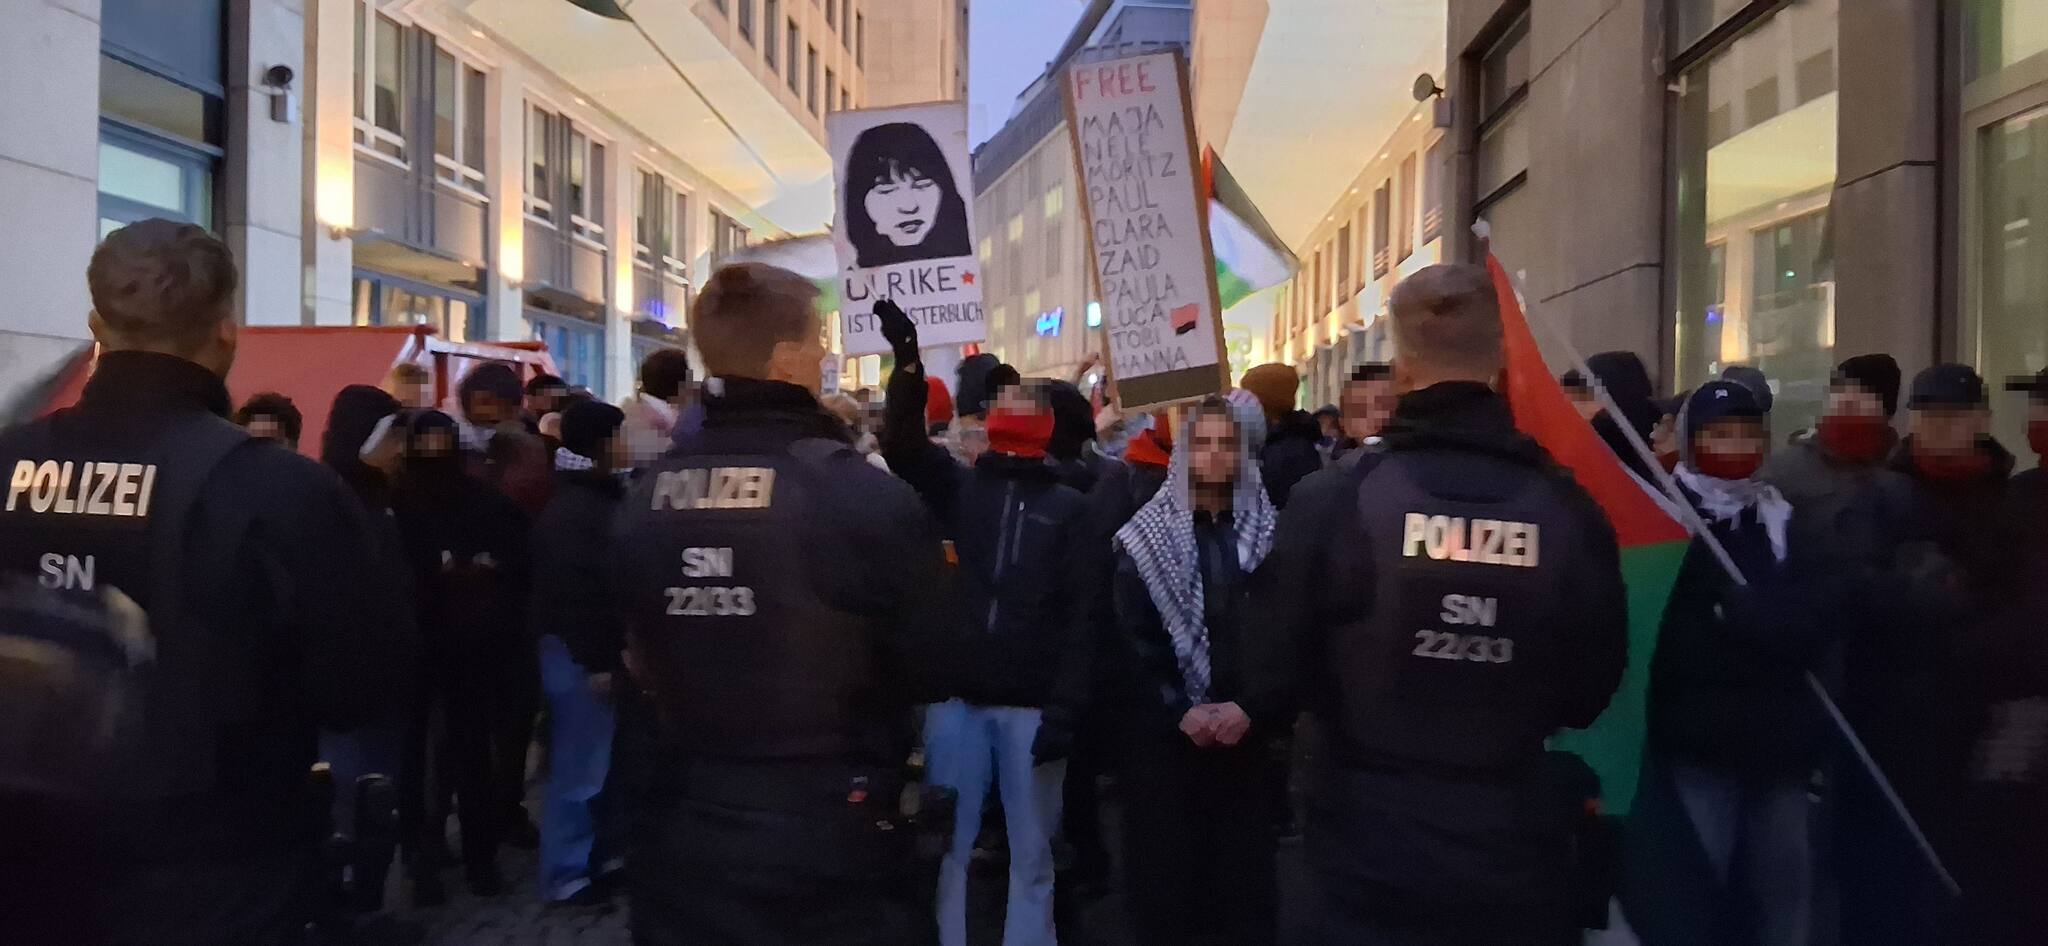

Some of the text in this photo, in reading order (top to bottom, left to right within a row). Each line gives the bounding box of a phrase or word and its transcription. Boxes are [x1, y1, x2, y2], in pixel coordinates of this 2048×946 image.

[1076, 61, 1157, 100] FREE
[1083, 103, 1164, 138] MAJA
[1087, 151, 1177, 184] MORITZ
[1090, 180, 1159, 216] PAUL
[1095, 212, 1173, 247] CLARA
[1100, 244, 1160, 276] ZAID
[846, 264, 957, 301] ULRIKE
[1103, 272, 1179, 306] PAULA
[848, 313, 875, 334] IST
[1106, 302, 1168, 331] LUCA
[5, 459, 157, 517] POLIZEI
[651, 467, 776, 511] POLIZEI
[1402, 512, 1540, 568] POLIZEI
[37, 552, 95, 591] SN
[681, 547, 733, 578] SN
[1440, 593, 1498, 627] SN
